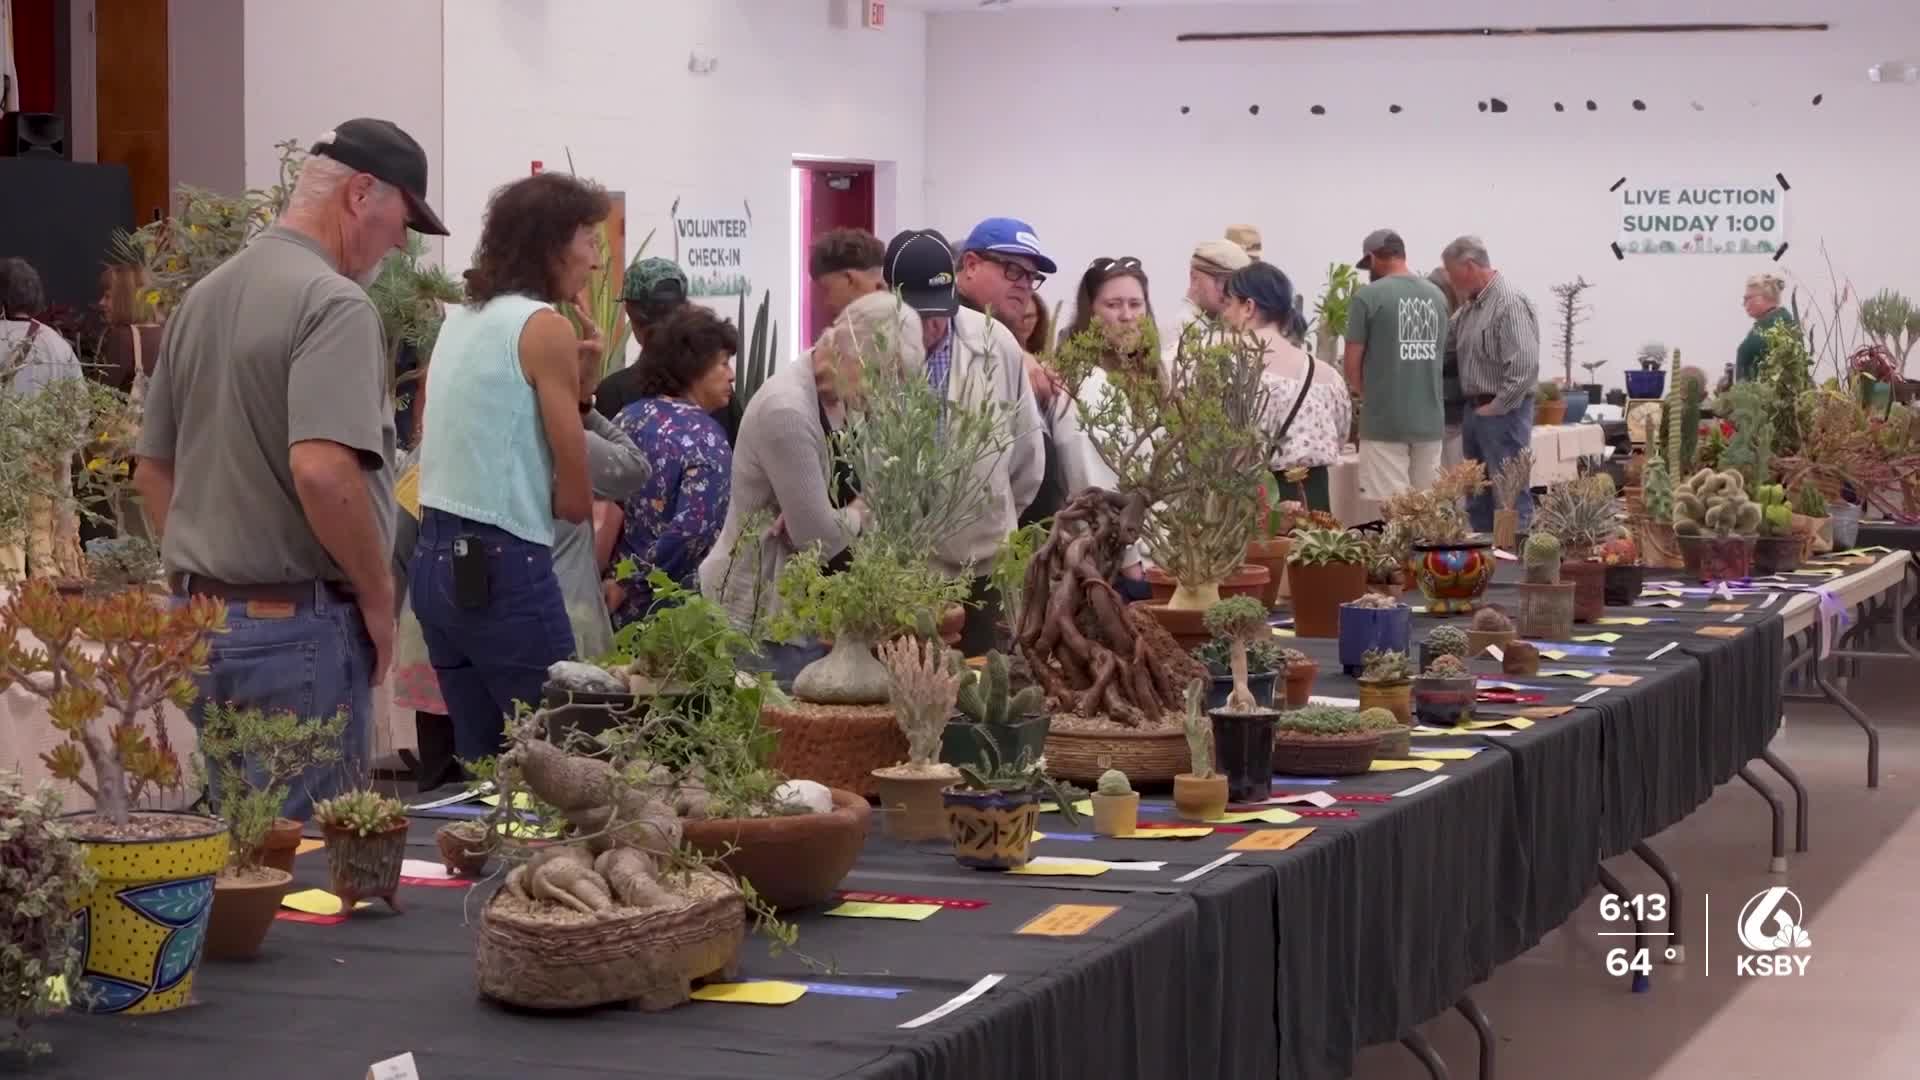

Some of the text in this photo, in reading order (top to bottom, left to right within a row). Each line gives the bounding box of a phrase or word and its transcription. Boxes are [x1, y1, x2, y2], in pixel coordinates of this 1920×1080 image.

[1623, 189, 1775, 205] LIVE AUCTION
[678, 219, 747, 238] VOLUNTEER
[1623, 215, 1775, 232] SUNDAY 1:00
[688, 248, 741, 267] CHECK-IN
[1400, 343, 1437, 360] CCCSS
